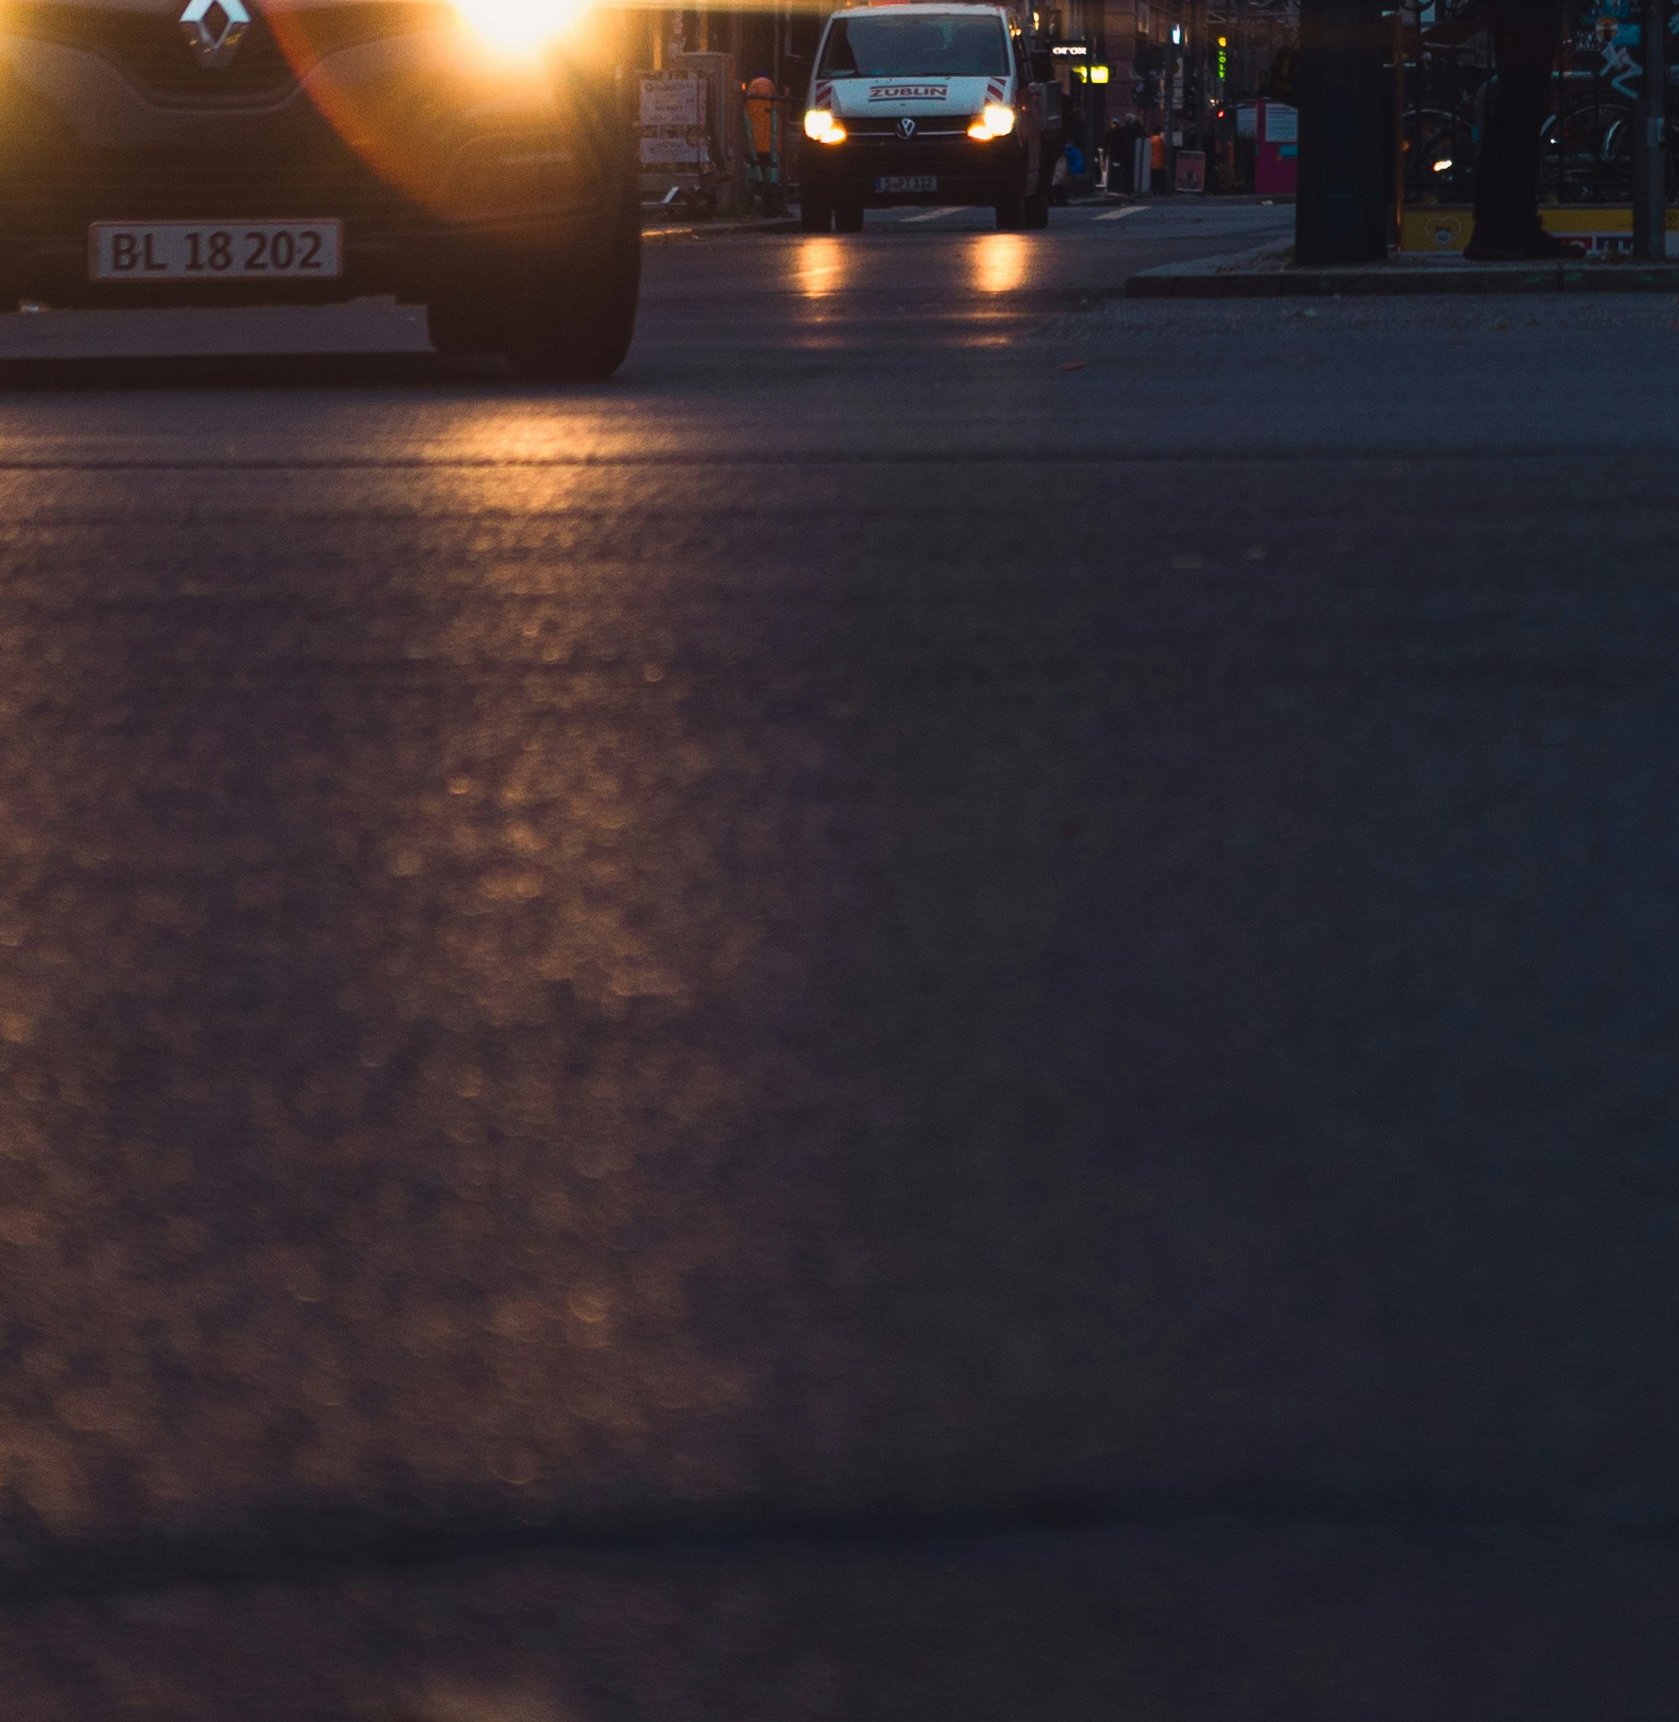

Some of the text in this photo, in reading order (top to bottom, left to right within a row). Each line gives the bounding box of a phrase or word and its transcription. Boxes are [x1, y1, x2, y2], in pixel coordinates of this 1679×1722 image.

[112, 230, 322, 271] BL 18 202
